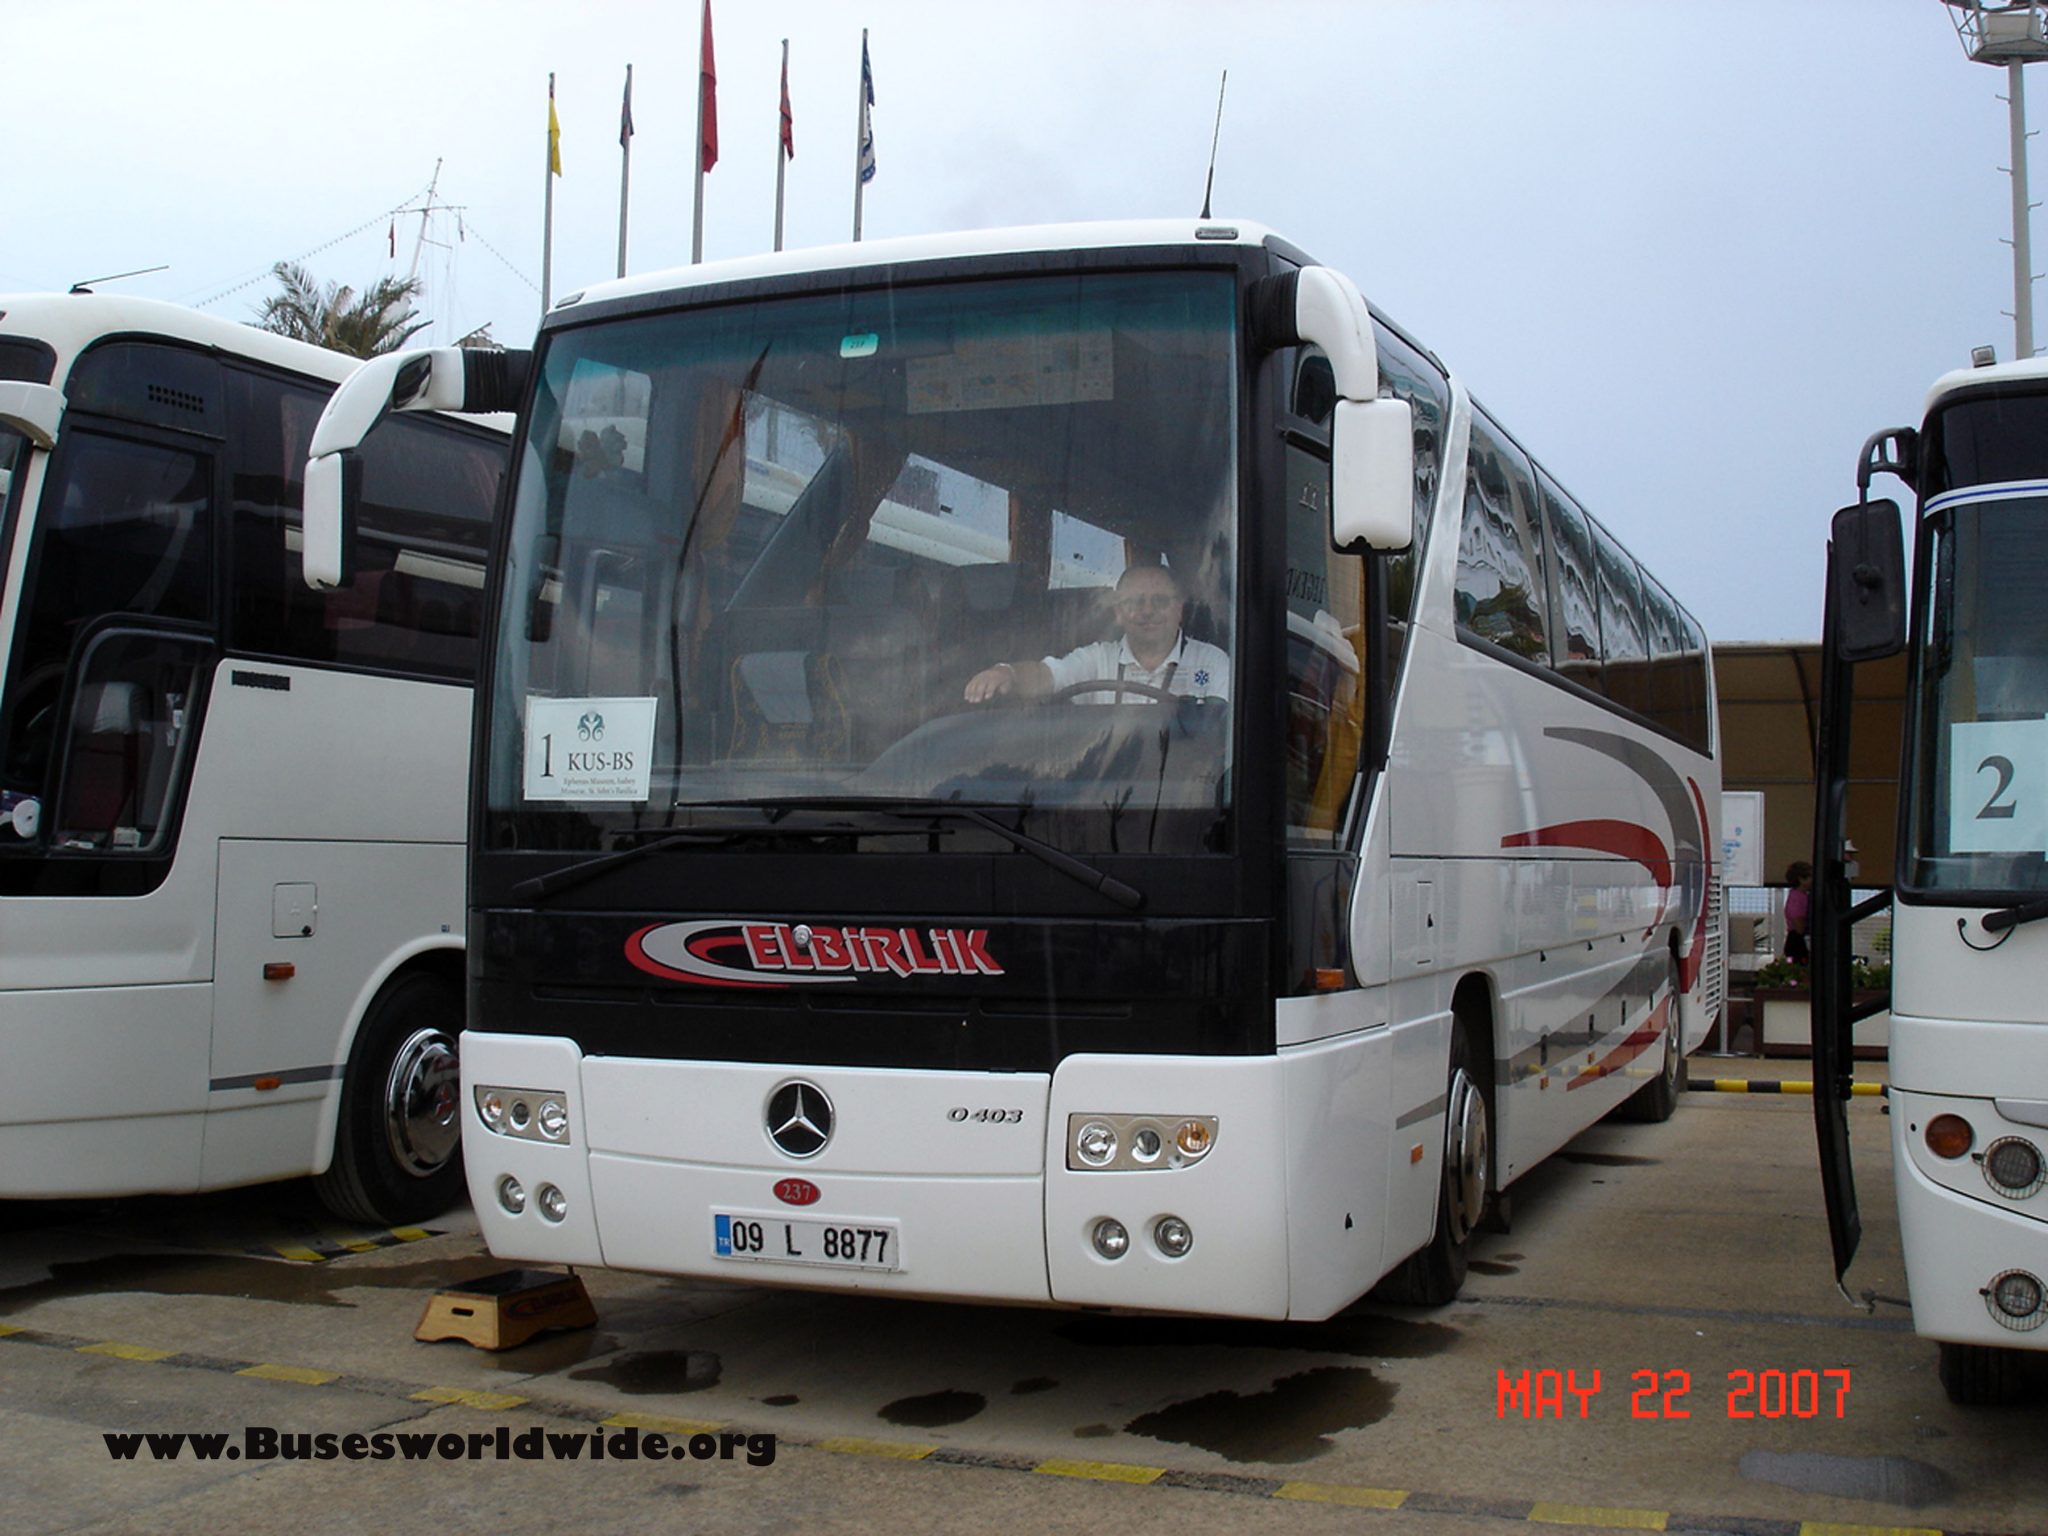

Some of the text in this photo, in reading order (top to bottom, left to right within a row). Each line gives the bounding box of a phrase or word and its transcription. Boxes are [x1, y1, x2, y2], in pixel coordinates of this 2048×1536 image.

[540, 733, 554, 778] 1
[567, 751, 634, 771] KUS-BS
[1975, 755, 2018, 820] 2
[970, 1108, 1023, 1124] 403
[783, 1183, 811, 1200] 237
[718, 1237, 731, 1247] TR
[732, 1221, 888, 1263] 09 L 8877
